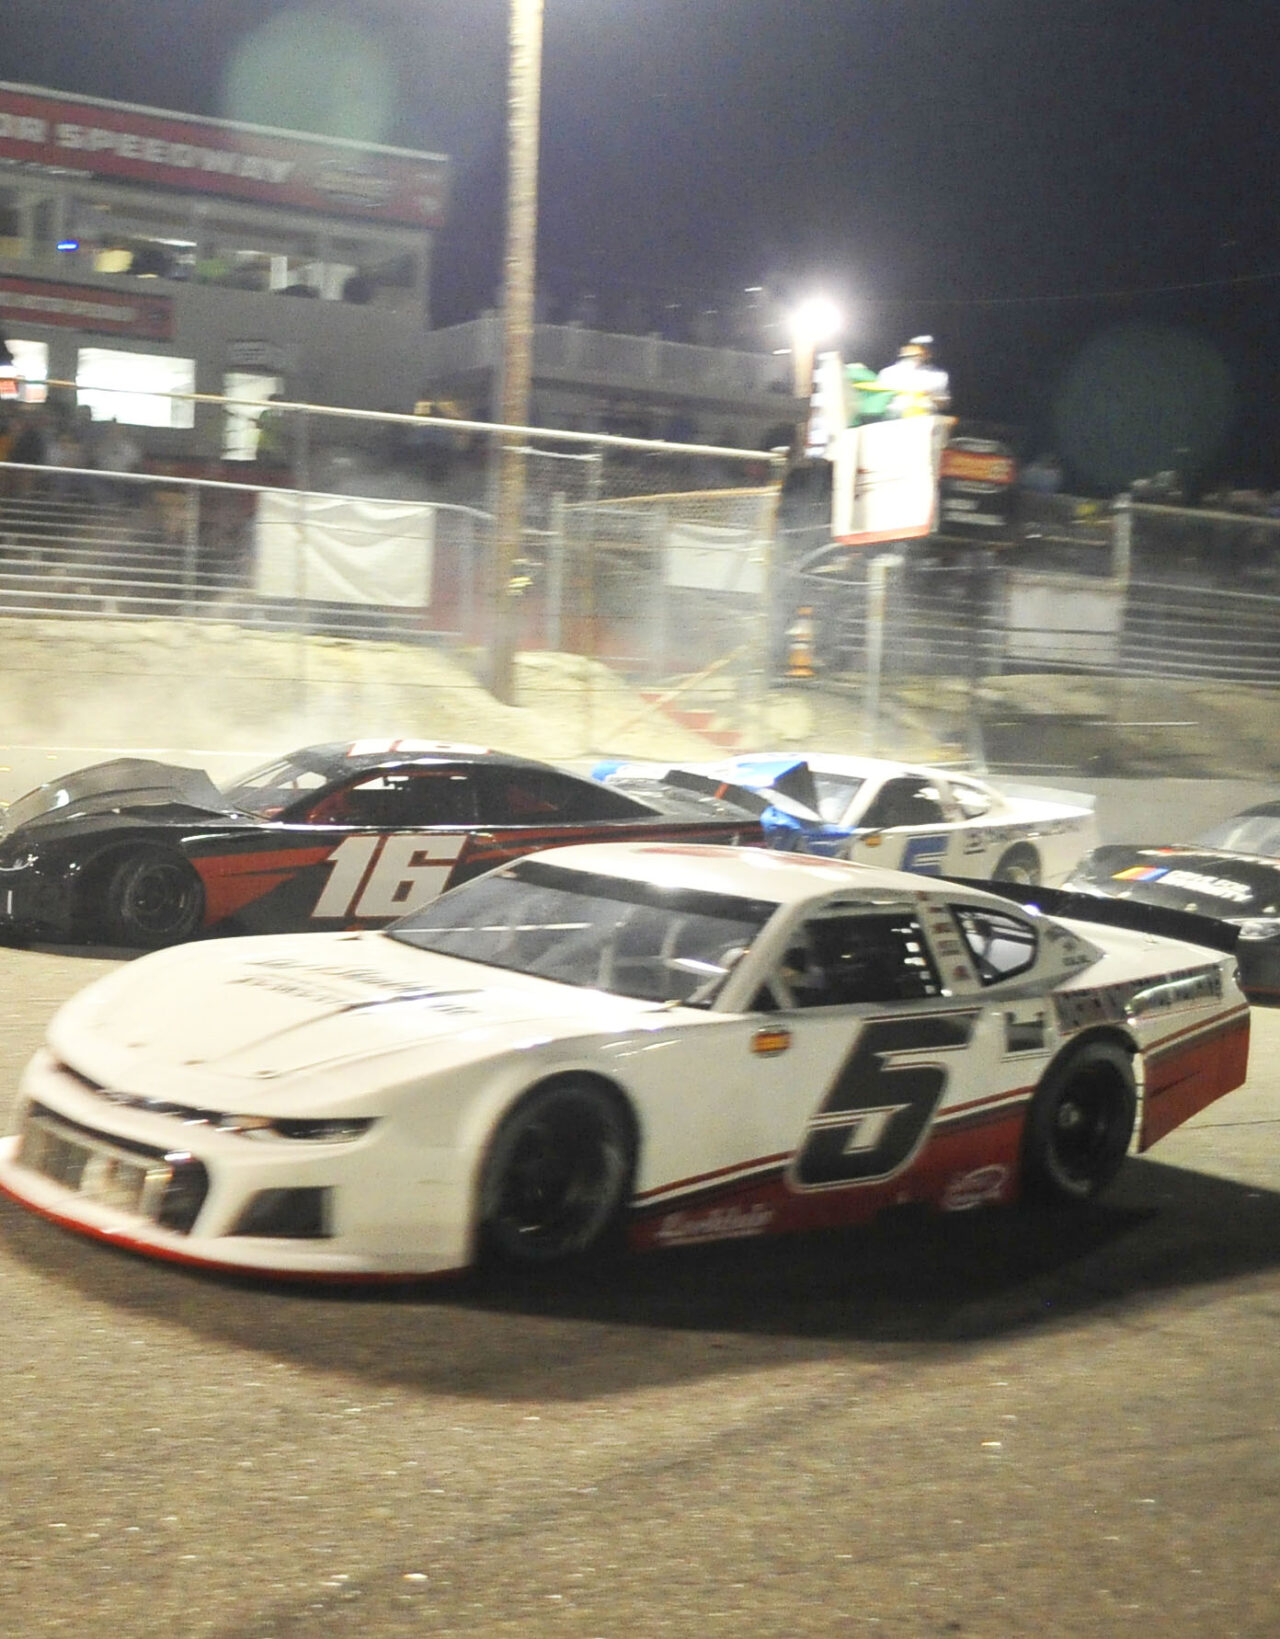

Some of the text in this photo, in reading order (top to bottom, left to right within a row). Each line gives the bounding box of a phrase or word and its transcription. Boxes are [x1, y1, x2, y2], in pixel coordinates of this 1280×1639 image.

[56, 122, 297, 184] SPEEDWAY
[310, 834, 468, 918] 16
[786, 1005, 984, 1195] 5
